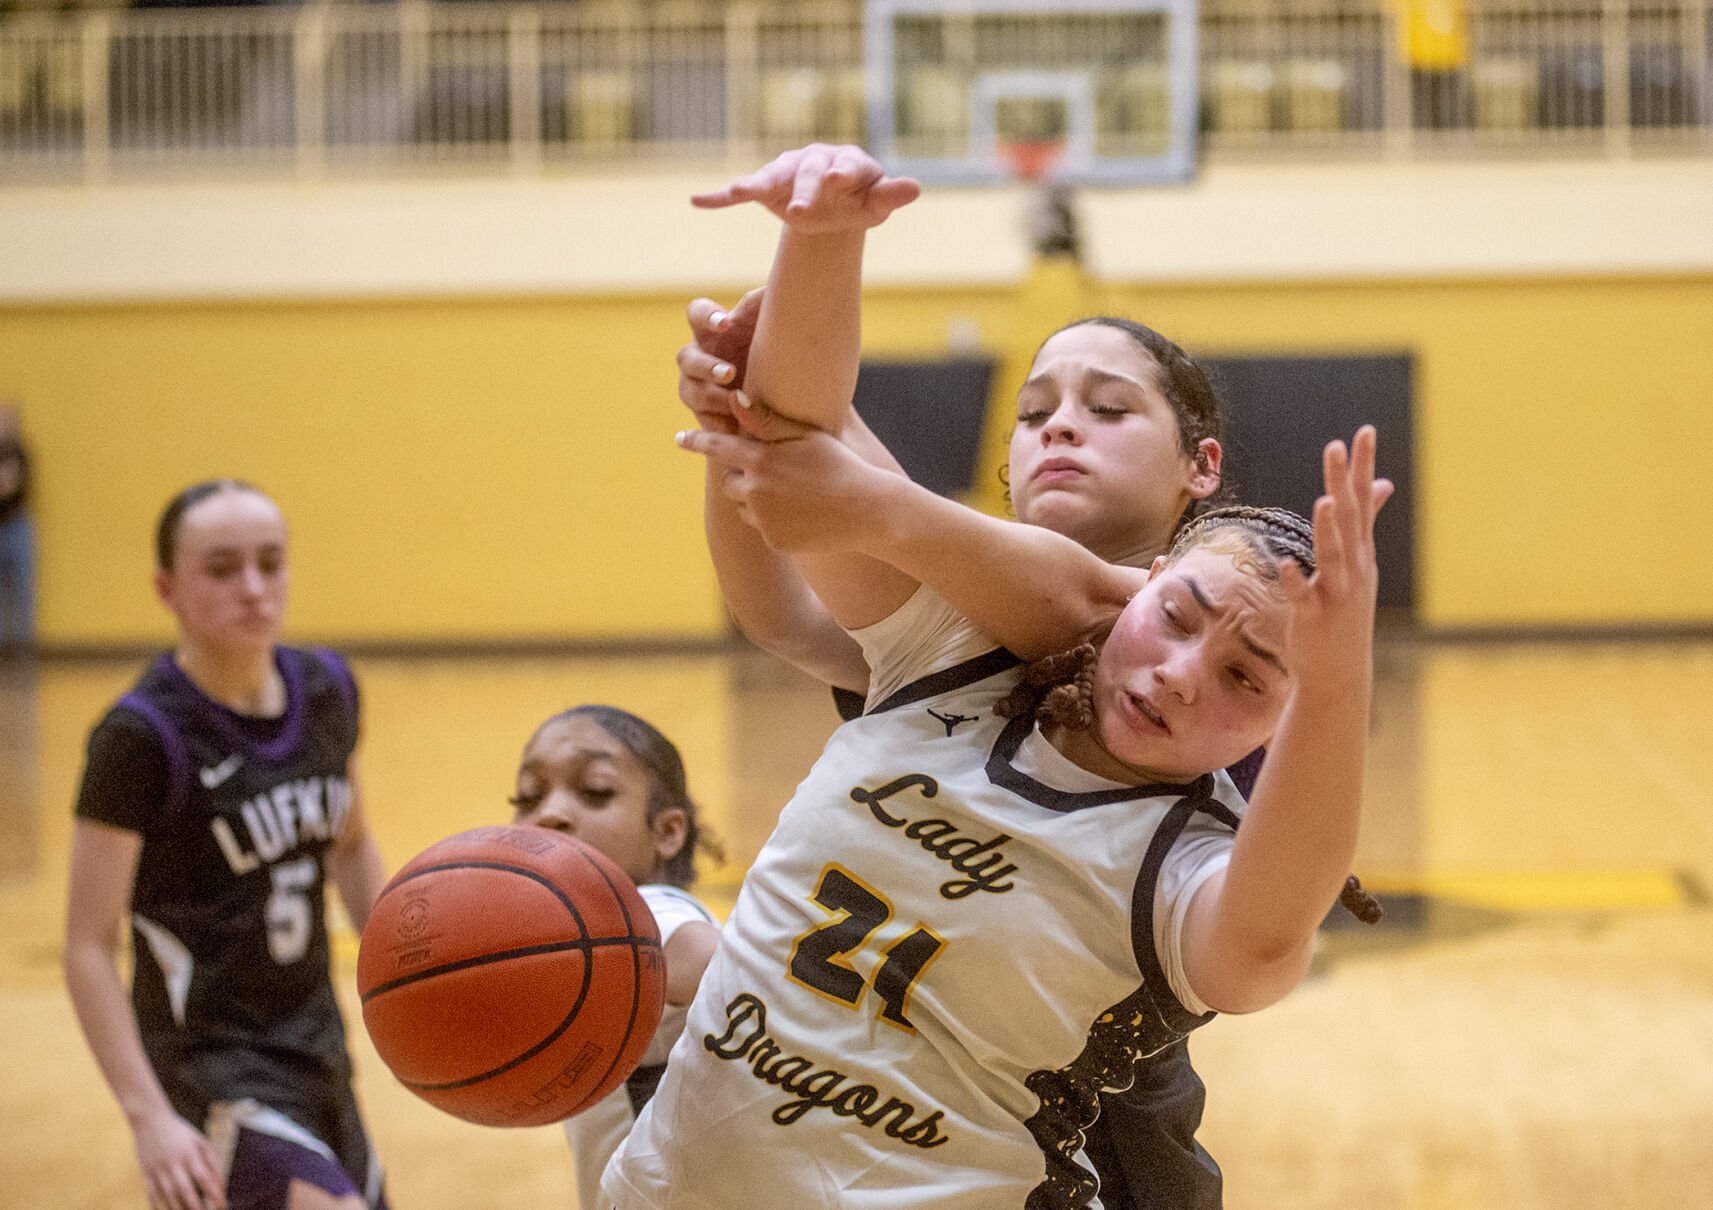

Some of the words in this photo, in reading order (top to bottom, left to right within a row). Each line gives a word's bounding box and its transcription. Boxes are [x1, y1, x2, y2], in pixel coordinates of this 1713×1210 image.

[850, 773, 1019, 900] Lady
[265, 857, 319, 965] 5
[784, 861, 949, 1037] 21
[704, 992, 949, 1150] Dragons
